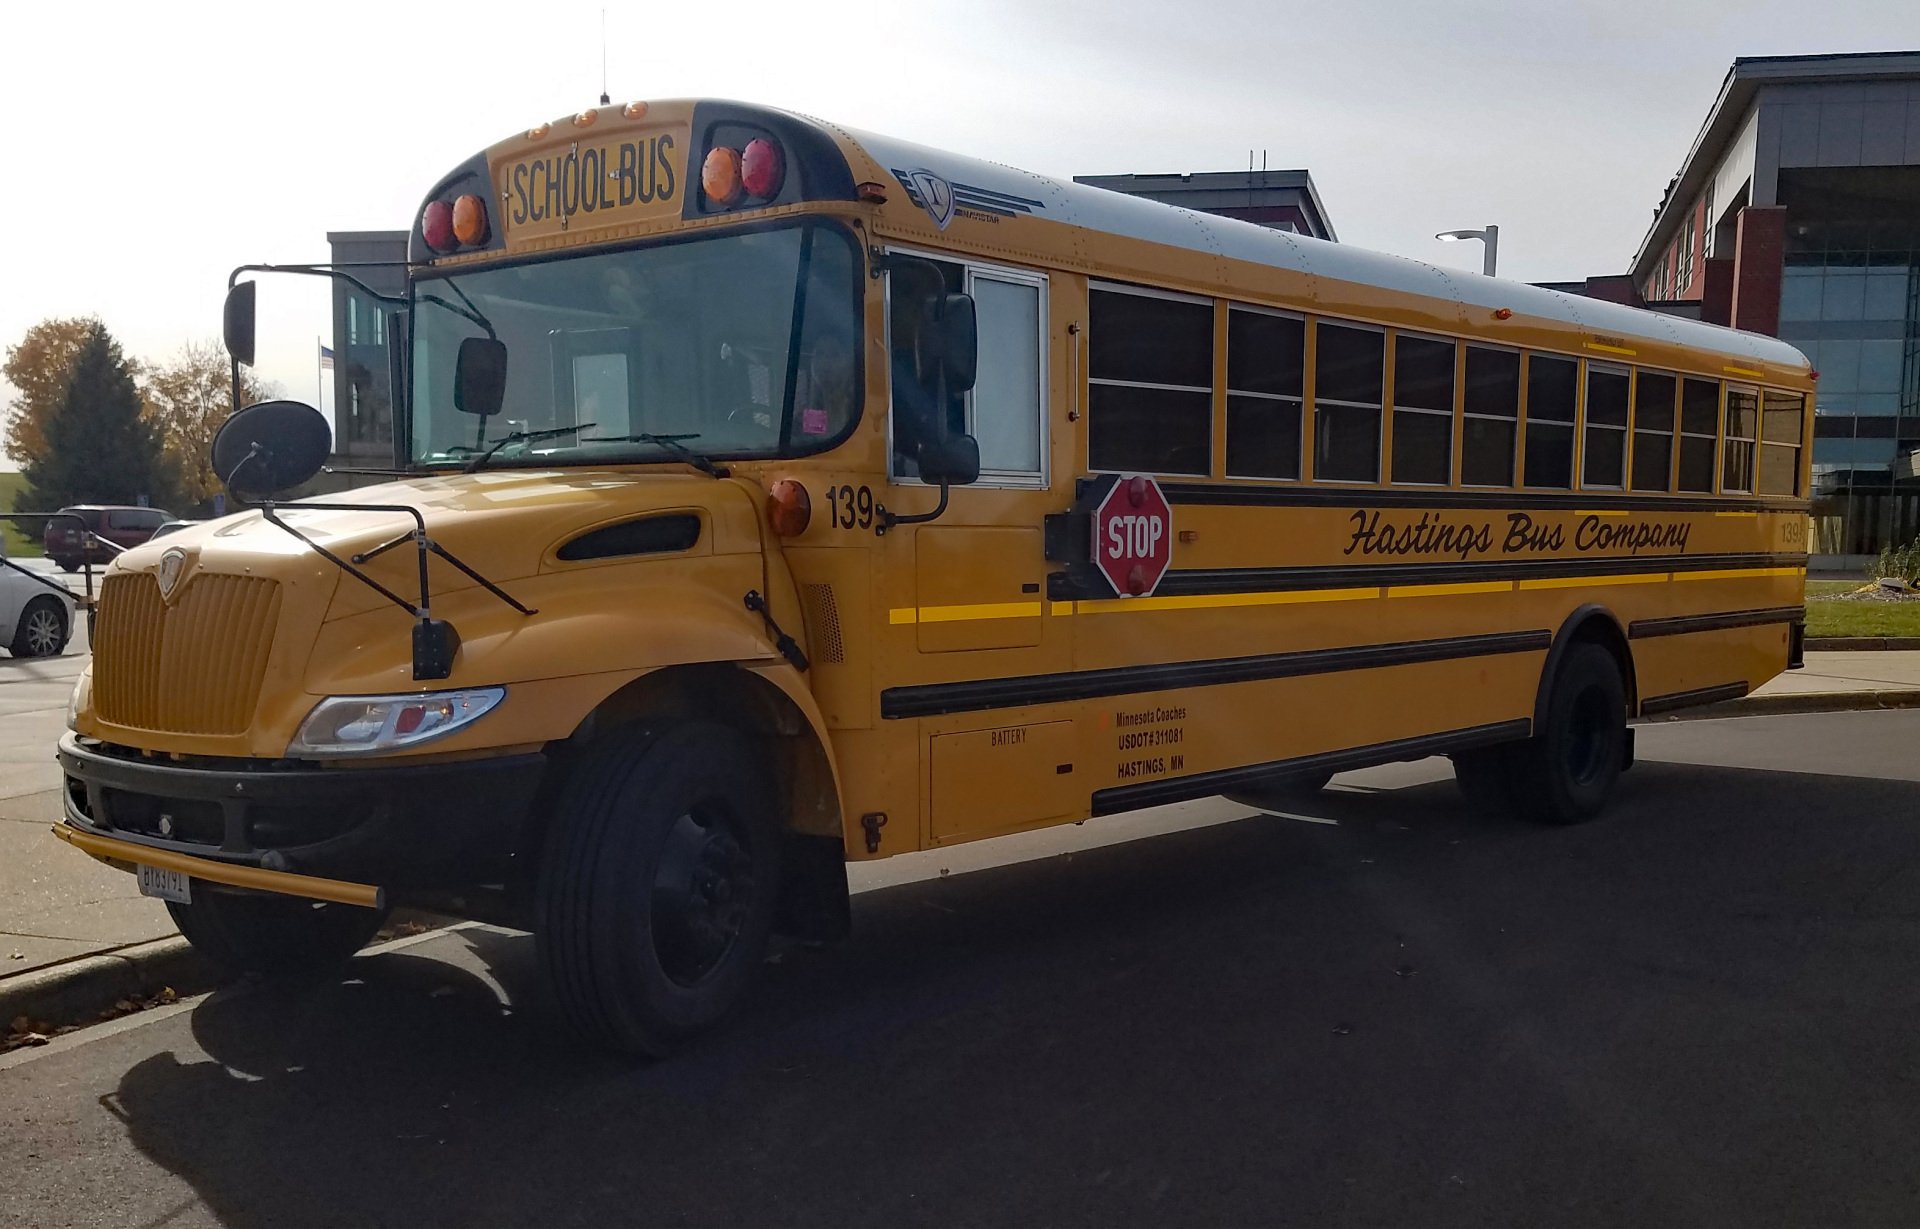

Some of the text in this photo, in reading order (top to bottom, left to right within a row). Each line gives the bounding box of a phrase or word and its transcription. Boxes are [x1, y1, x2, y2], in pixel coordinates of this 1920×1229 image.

[513, 134, 675, 225] SCHOOL BUS
[825, 485, 873, 530] 139
[1108, 515, 1163, 559] STOP
[1343, 509, 1692, 561] Hastings Bus Company
[991, 728, 1027, 747] BATTERY
[1116, 705, 1187, 728] Minnesota Coaches
[1117, 755, 1184, 779] HASTINGS, MN
